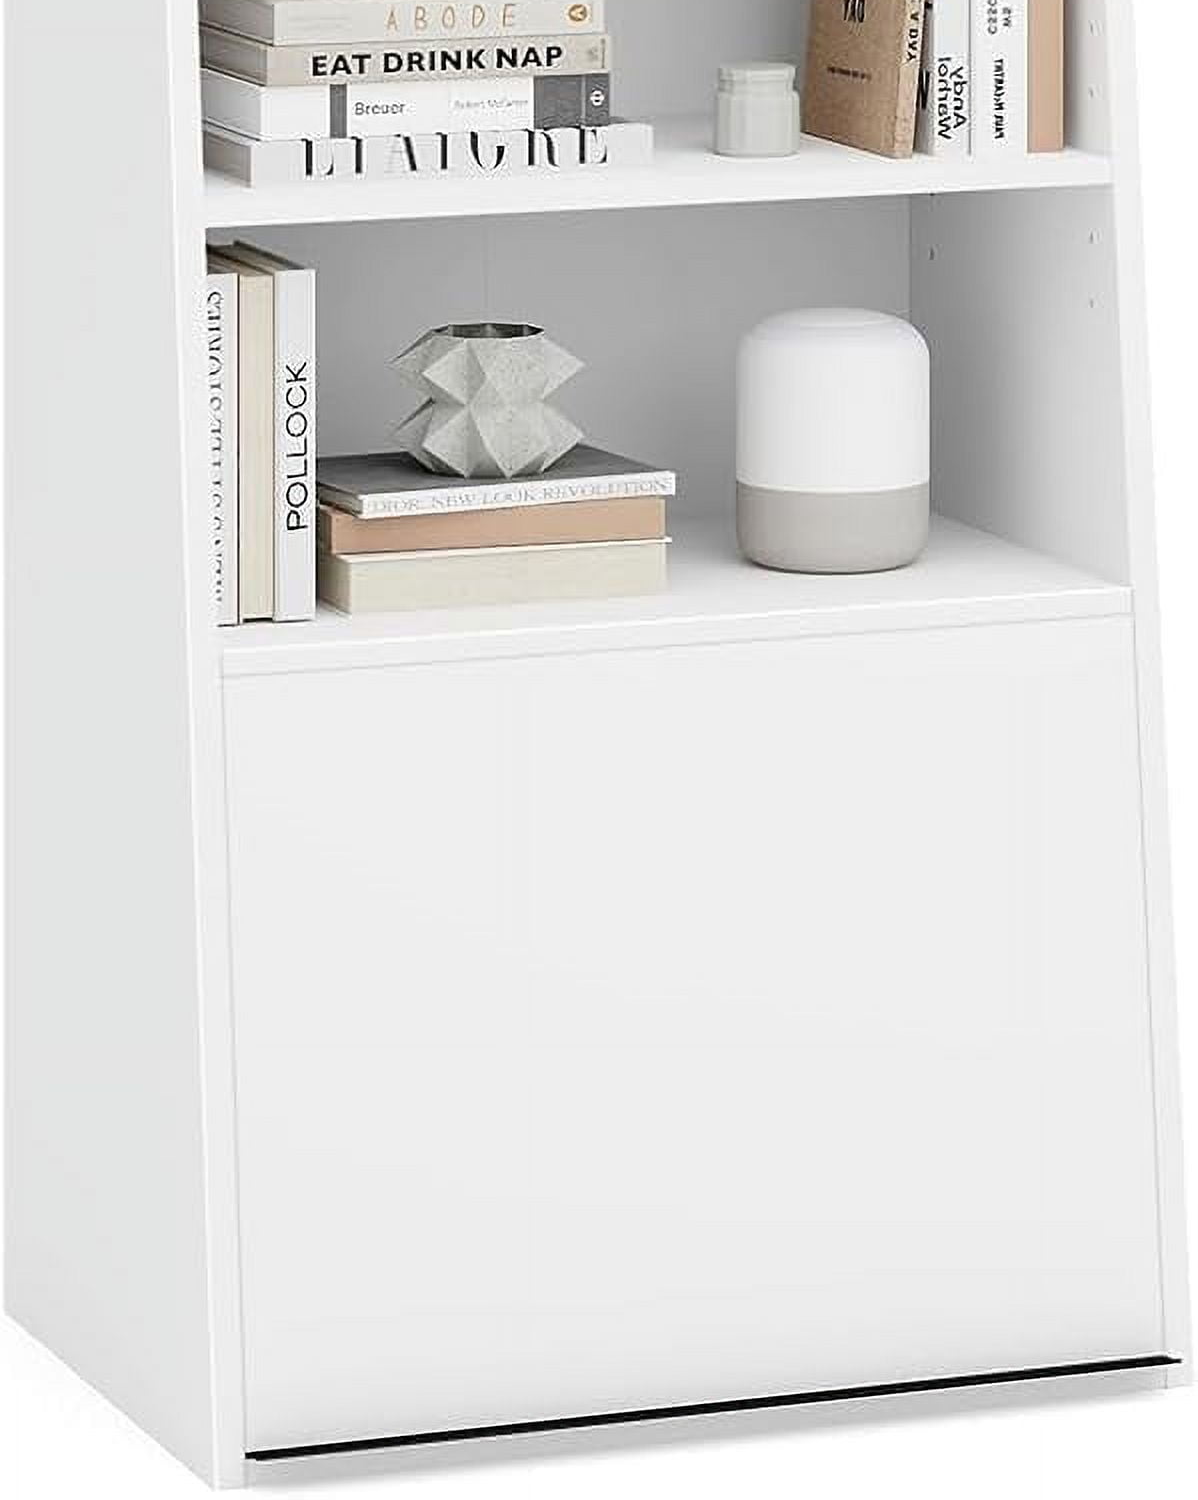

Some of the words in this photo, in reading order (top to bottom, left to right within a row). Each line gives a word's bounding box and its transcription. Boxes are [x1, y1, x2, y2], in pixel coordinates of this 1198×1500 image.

[386, 2, 517, 31] ABODE
[312, 53, 372, 77] EAT
[383, 48, 487, 73] DRINK
[496, 45, 563, 69] NAP
[354, 101, 406, 116] Breuer
[286, 361, 309, 531] POLLOCK
[431, 494, 478, 510] NEW
[540, 477, 673, 502] REVOLUTION
